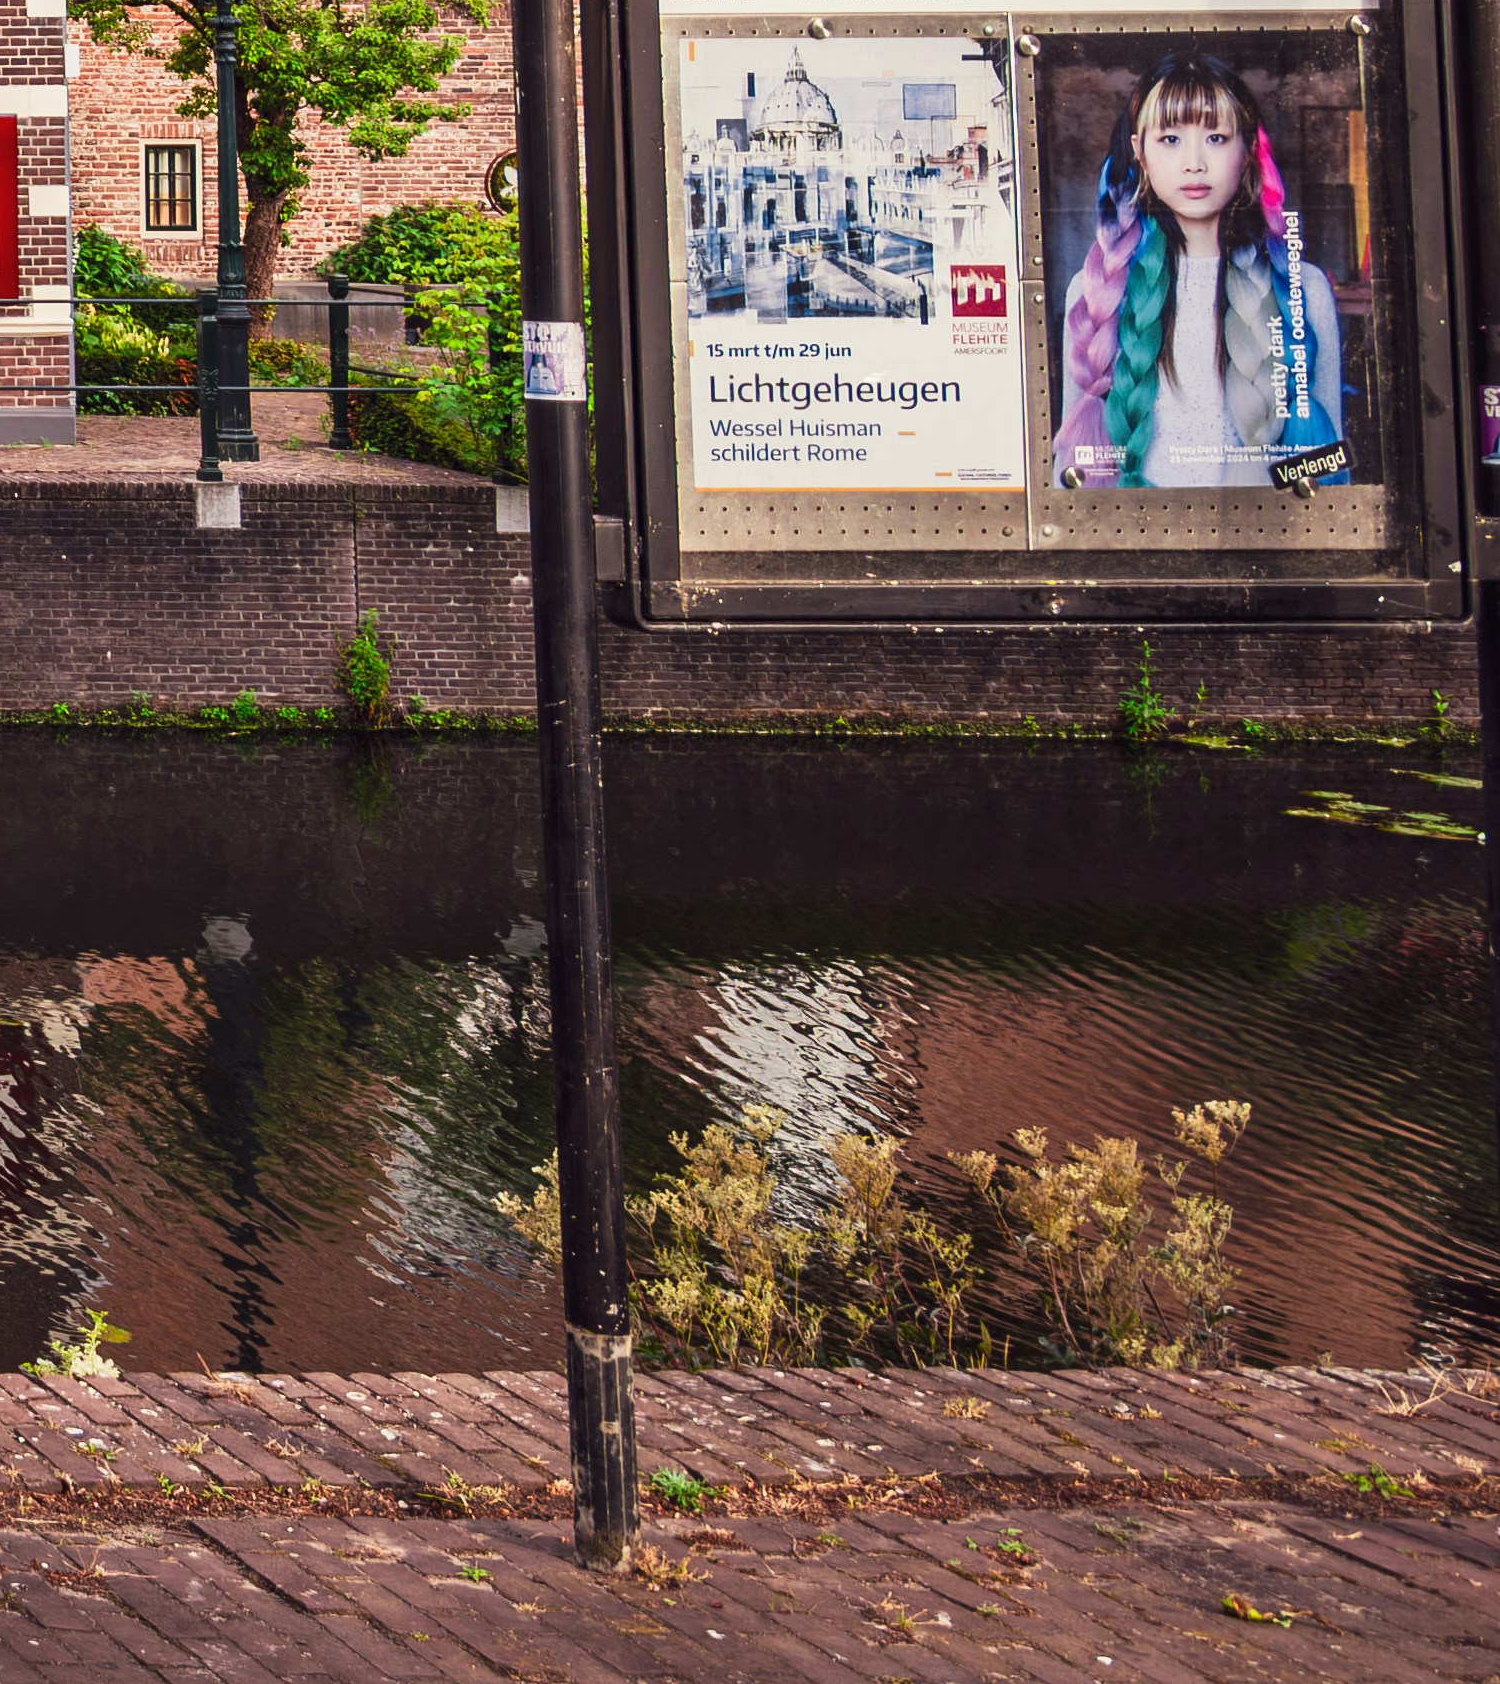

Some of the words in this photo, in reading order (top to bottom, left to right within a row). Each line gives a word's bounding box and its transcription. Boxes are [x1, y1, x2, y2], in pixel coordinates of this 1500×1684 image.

[1281, 211, 1305, 340] oosteweeghel
[952, 322, 1008, 333] MUSEUM
[952, 334, 1008, 345] FLEHITE
[1266, 315, 1284, 358] dark
[706, 344, 724, 358] 15
[728, 345, 759, 358] mrt
[764, 344, 794, 358] t/m
[799, 344, 820, 358] 29
[824, 343, 852, 361] jun
[709, 373, 961, 410] Lichtgeheugen
[1270, 363, 1291, 419] pretty
[1289, 345, 1310, 419] annabel
[709, 419, 783, 437] Wessel
[790, 419, 882, 437] Huisman
[710, 443, 801, 461] schildert
[807, 444, 867, 461] Rome
[1277, 446, 1347, 483] Verlengd
